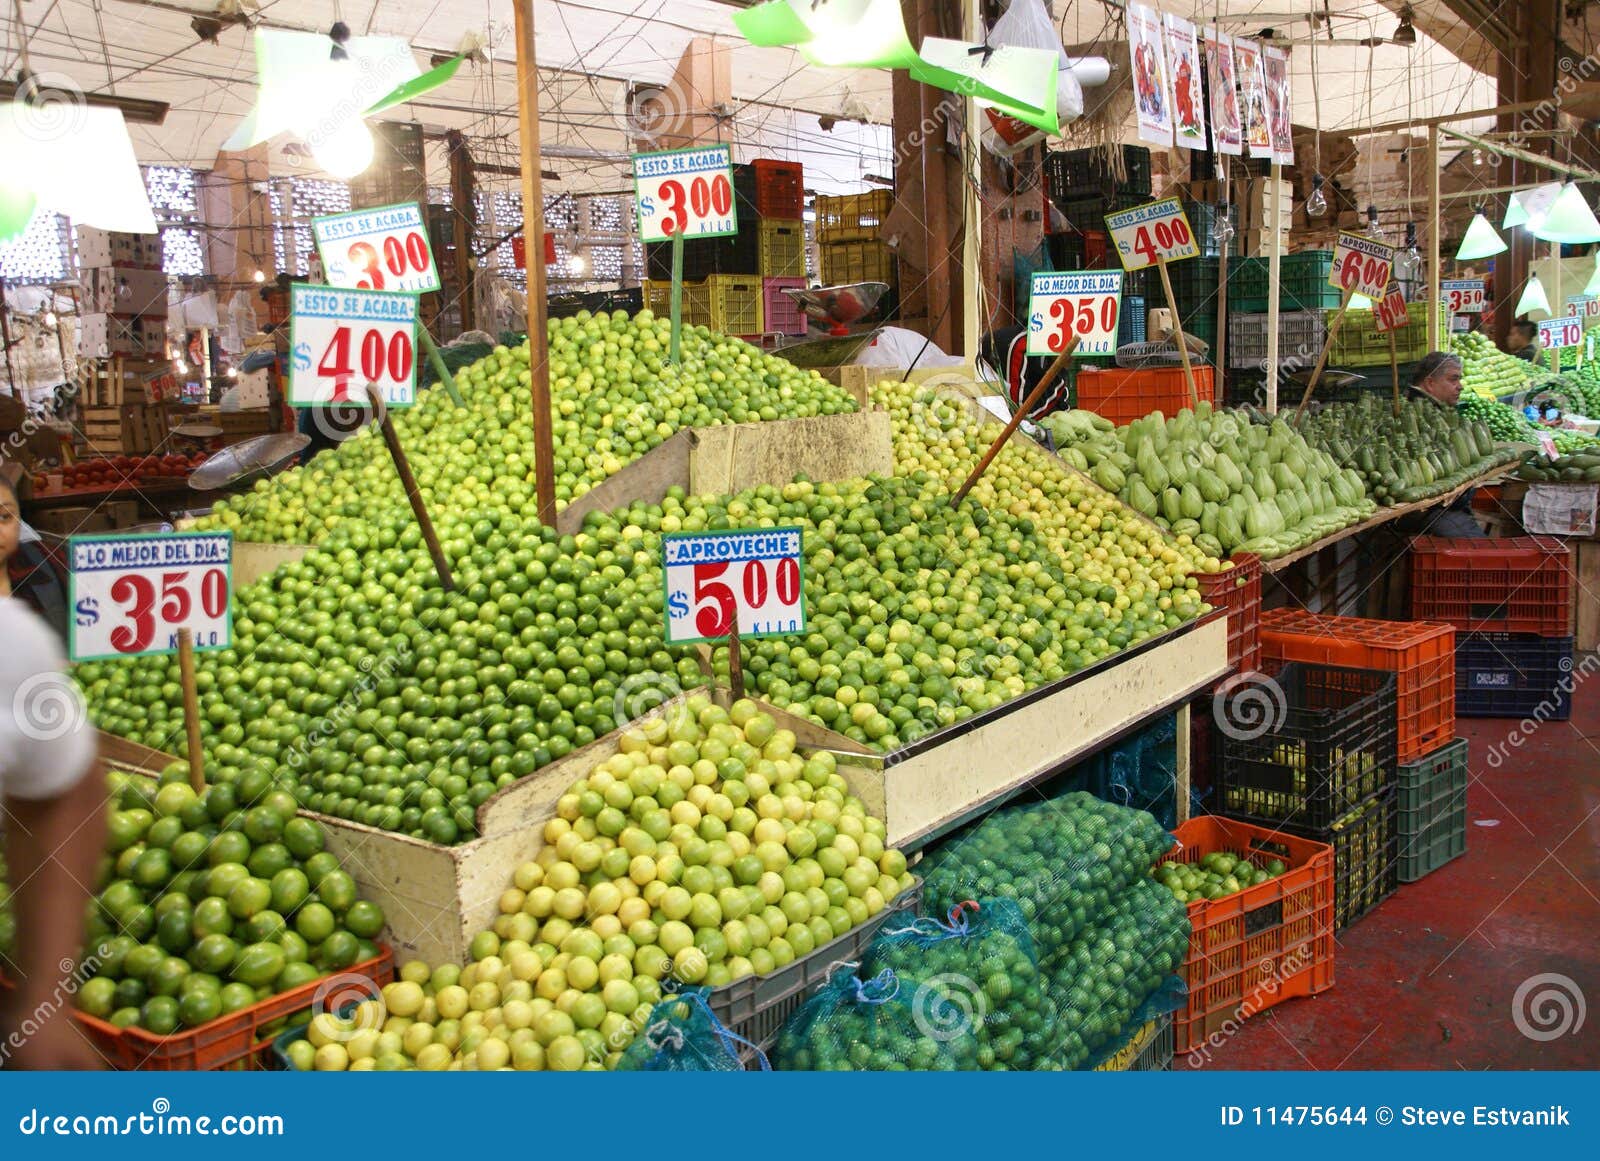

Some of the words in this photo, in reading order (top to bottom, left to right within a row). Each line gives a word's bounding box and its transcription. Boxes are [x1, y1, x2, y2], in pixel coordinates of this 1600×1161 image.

[642, 159, 669, 172] ESTO
[672, 157, 685, 169] SE
[688, 153, 724, 167] ACABA
[325, 221, 355, 237] ESTO
[359, 218, 372, 231] SE
[376, 211, 413, 228] ACABA
[1113, 214, 1134, 226] ESTO
[1136, 210, 1146, 220] SE
[1148, 203, 1176, 217] ACABA
[700, 220, 731, 233] KILO
[1168, 246, 1193, 258] KILO
[1342, 237, 1388, 257] APROVECHE
[1040, 280, 1050, 290] LO
[1052, 279, 1080, 290] MEJOR
[1082, 278, 1097, 289] DEL
[1099, 278, 1114, 289] DIA
[304, 295, 338, 311] ESTO
[344, 299, 359, 313] SE
[363, 300, 409, 316] ACABA
[1079, 341, 1108, 353] KILO
[87, 548, 106, 564] LO
[112, 545, 160, 562] MEJOR
[165, 544, 190, 559] DEL
[195, 543, 219, 558] DIA
[677, 537, 790, 559] APROVECHE
[753, 619, 797, 635] KILO
[169, 631, 218, 649] KLO
